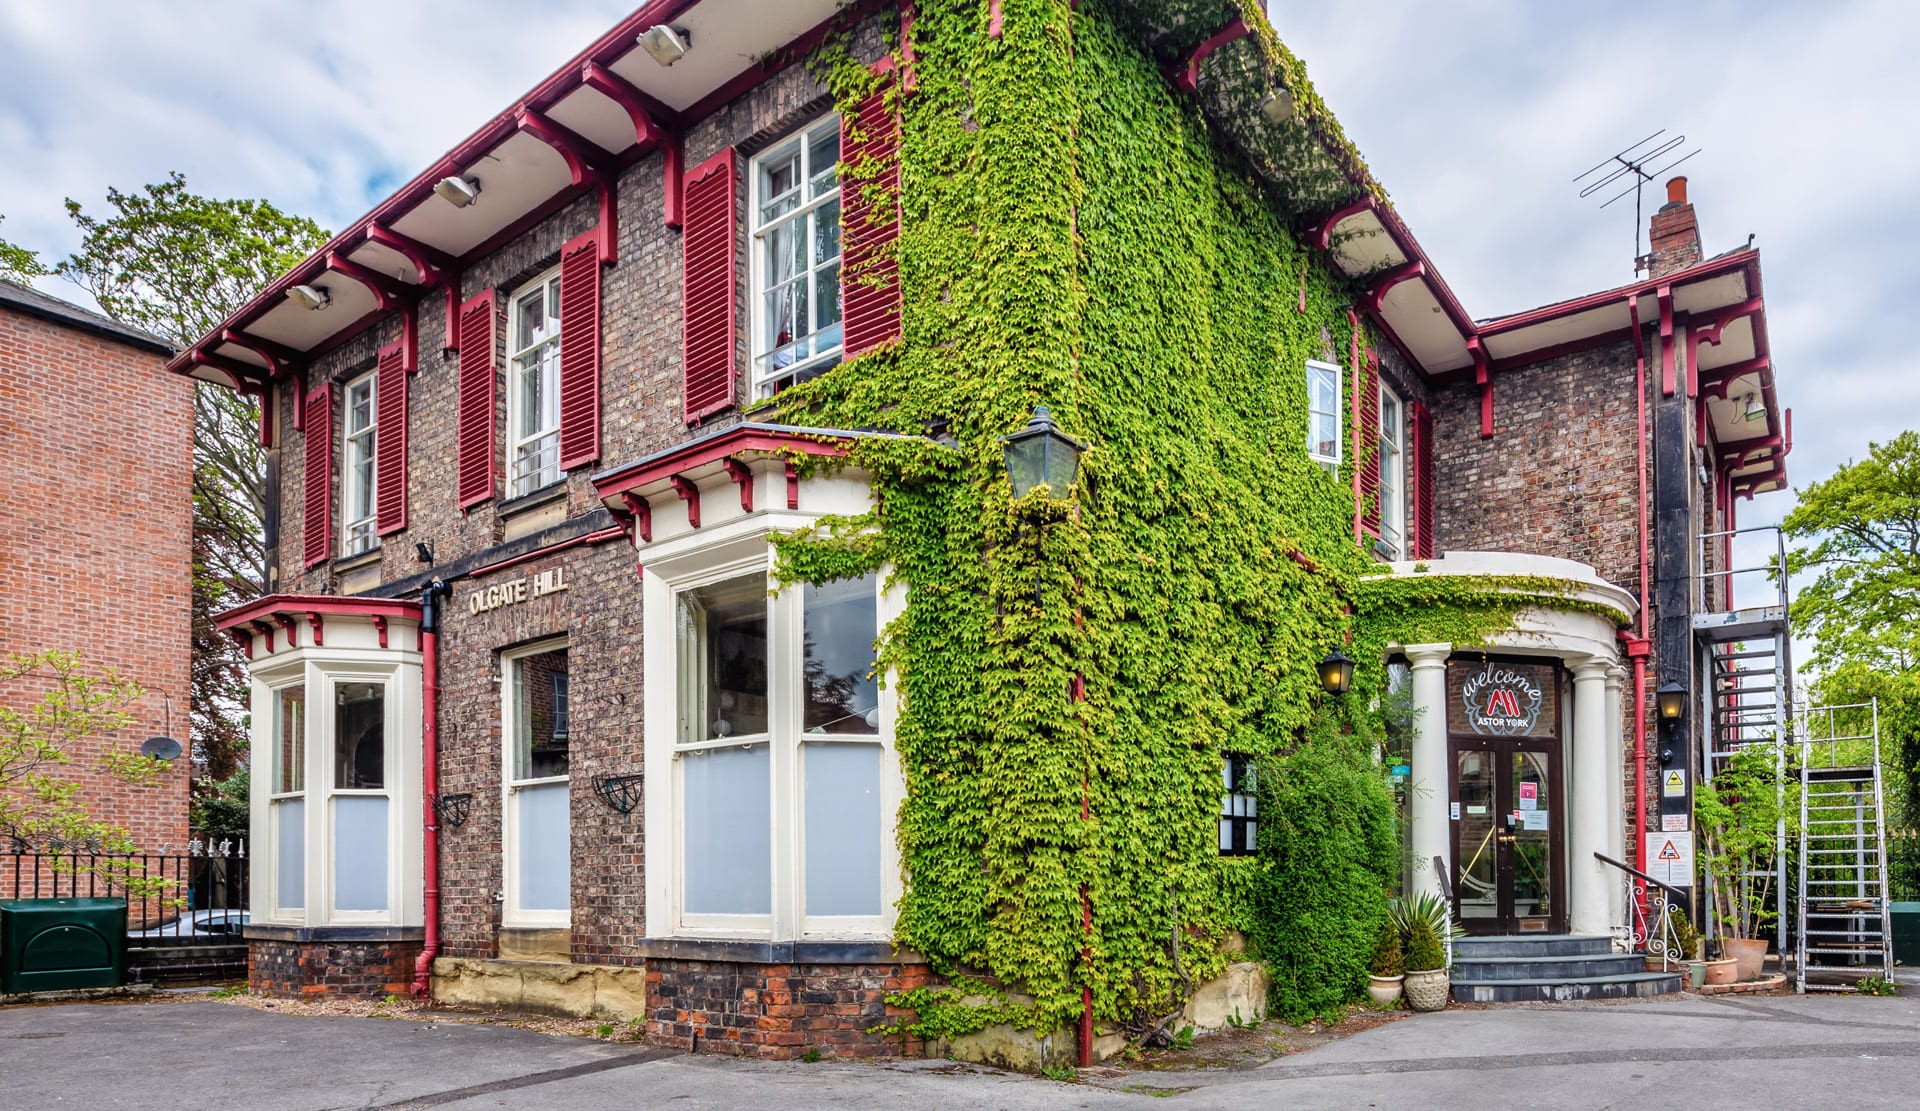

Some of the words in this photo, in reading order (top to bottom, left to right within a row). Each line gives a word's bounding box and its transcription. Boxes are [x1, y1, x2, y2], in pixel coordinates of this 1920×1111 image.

[470, 578, 527, 615] OLGATE
[533, 567, 569, 597] HILL
[1463, 662, 1541, 700] welcome
[1477, 717, 1505, 726] ASTOR
[1506, 718, 1529, 728] YORK
